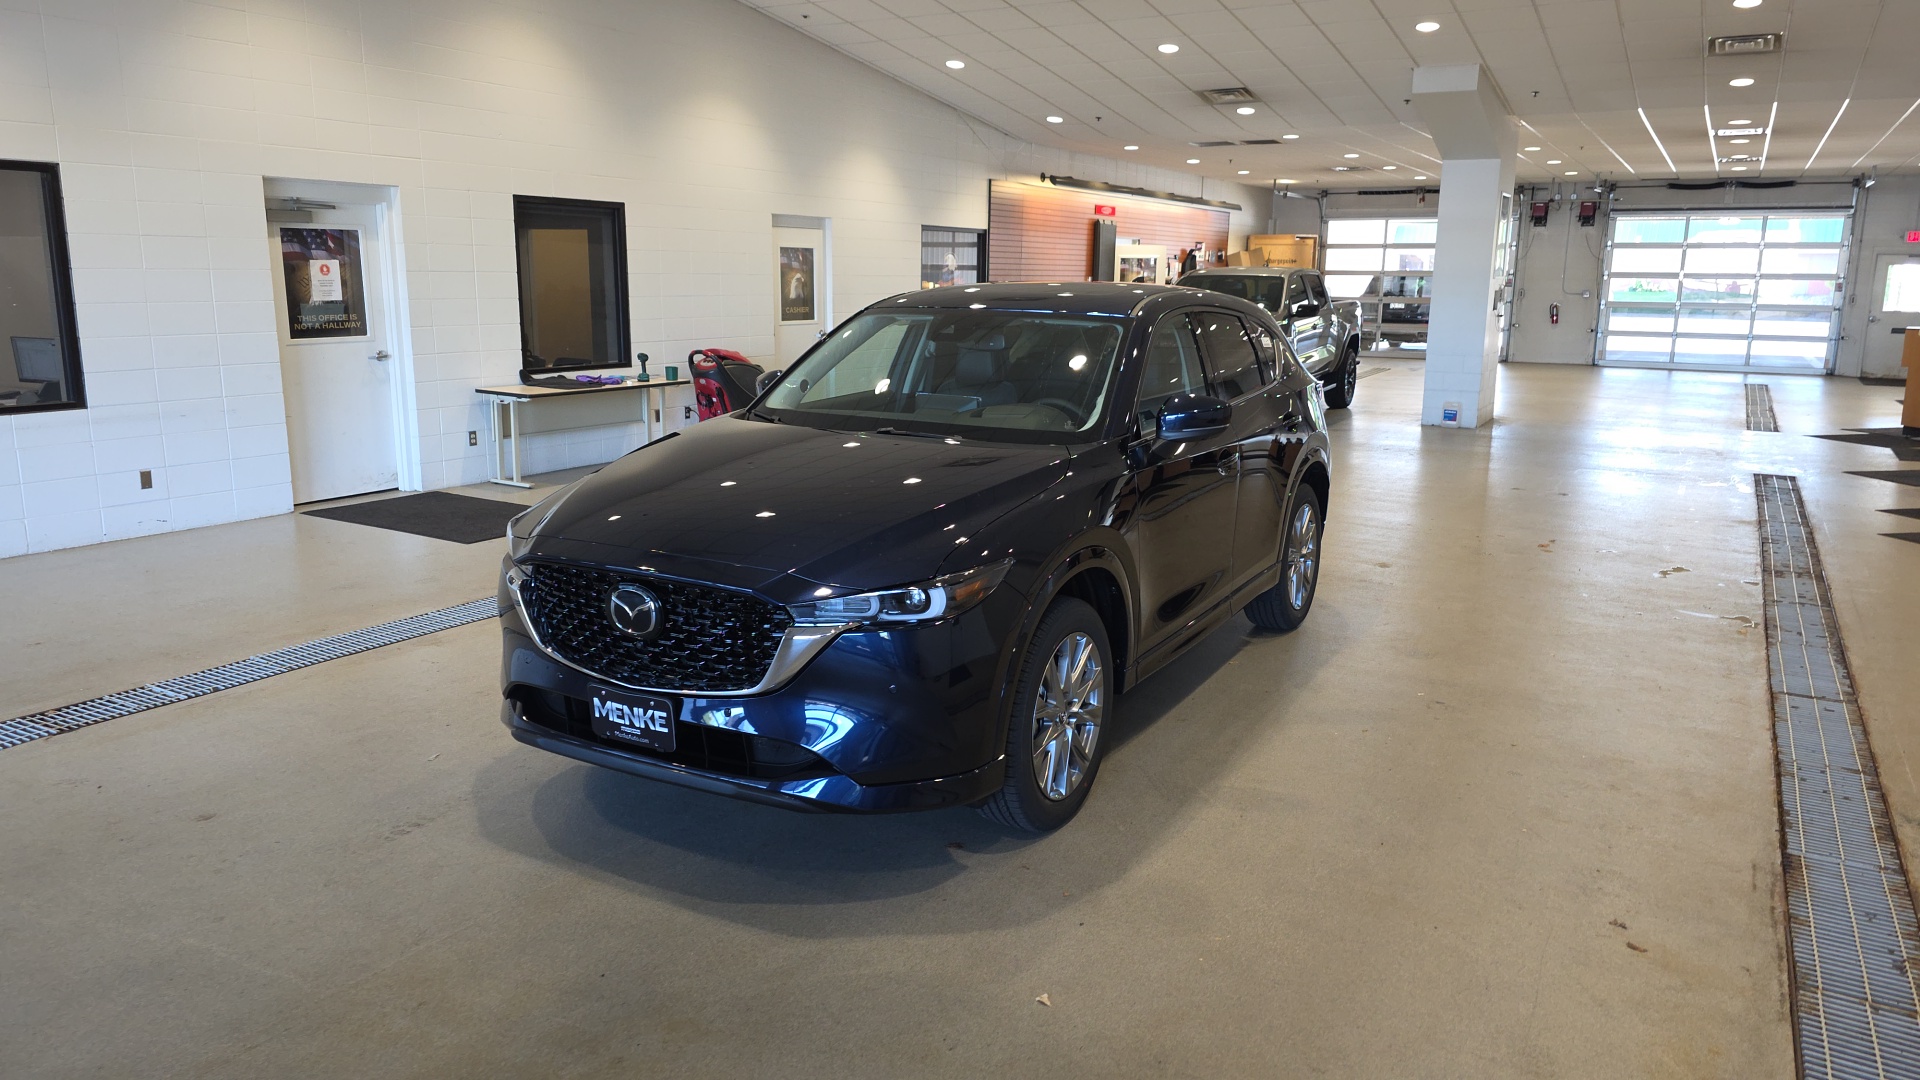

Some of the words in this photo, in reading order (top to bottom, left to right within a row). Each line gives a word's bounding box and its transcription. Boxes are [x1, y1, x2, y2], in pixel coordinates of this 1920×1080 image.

[785, 306, 810, 314] CASHIER
[297, 314, 317, 322] THIS
[318, 313, 348, 322] OFFICE
[322, 321, 361, 329] HALLWAY
[593, 697, 669, 733] MENKE
